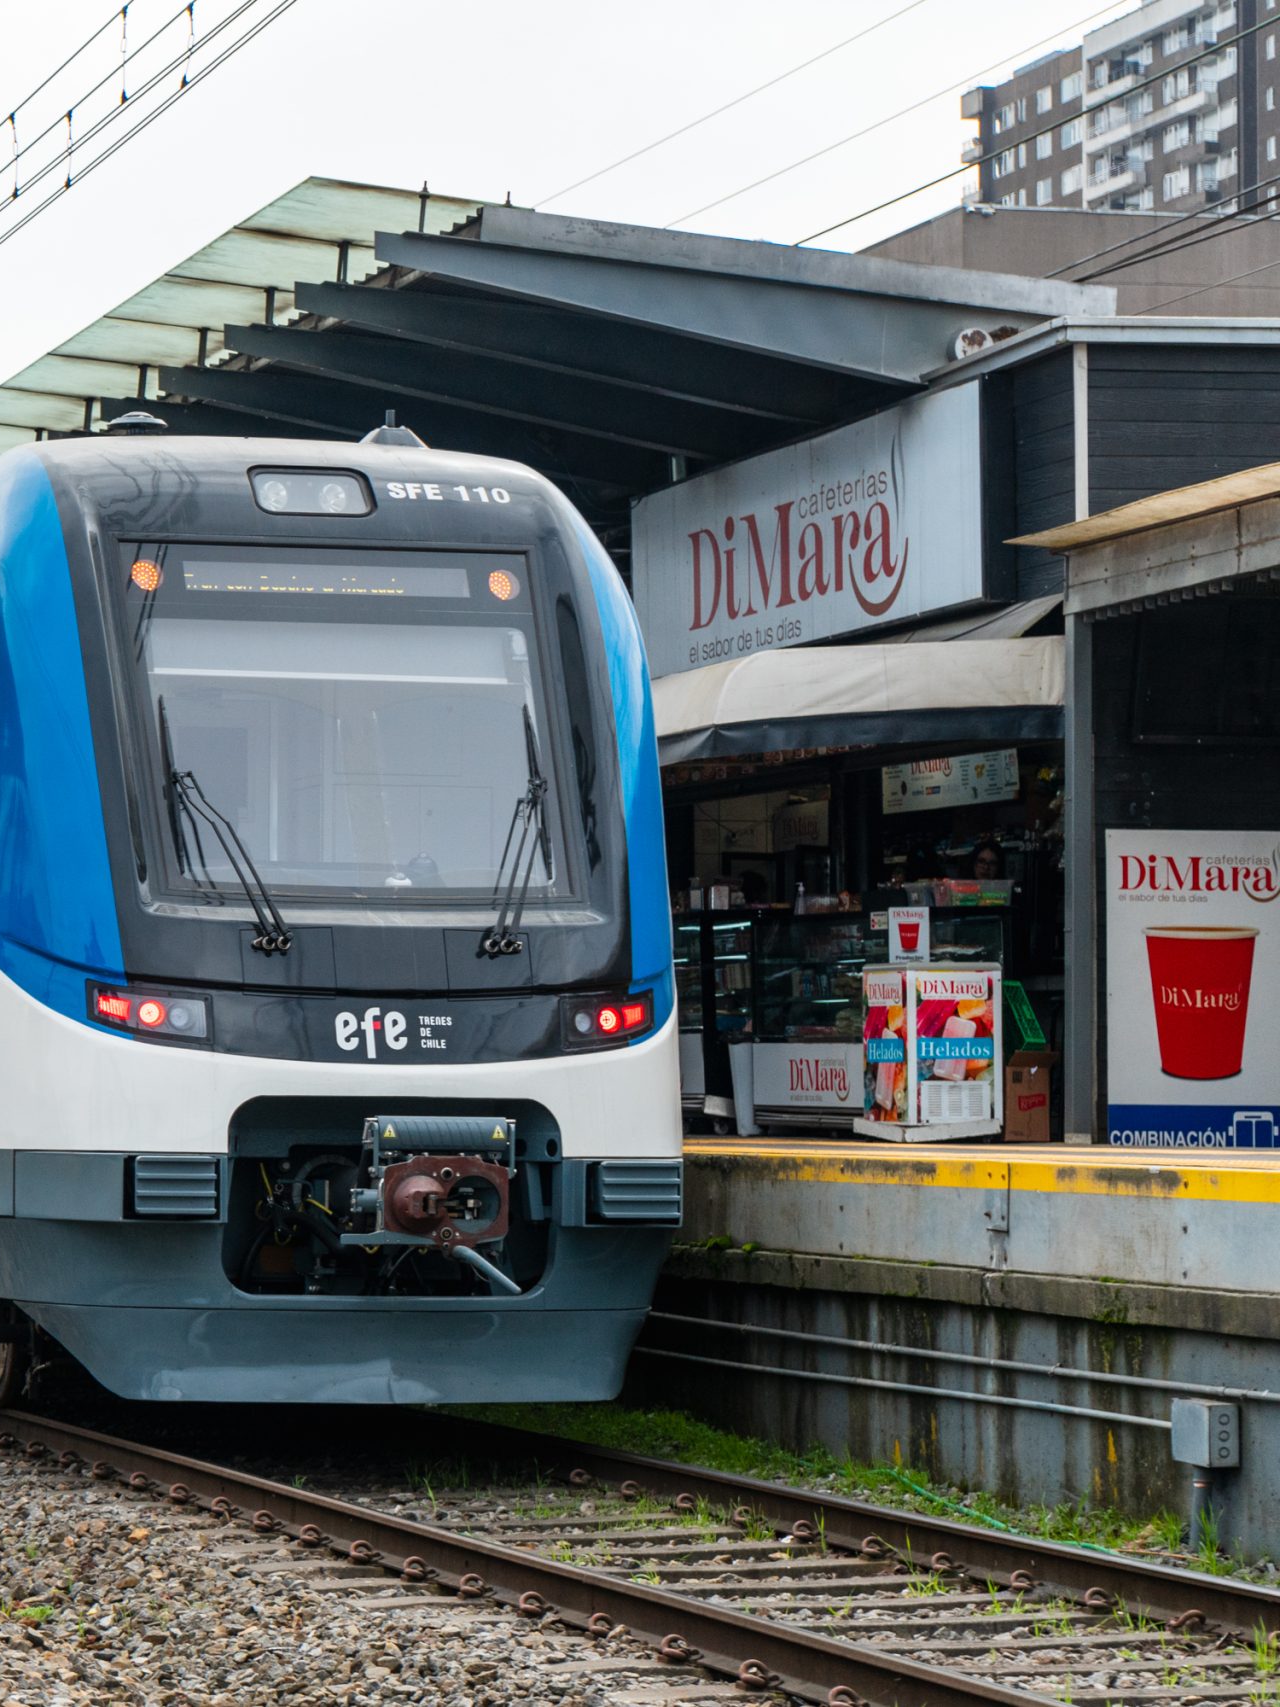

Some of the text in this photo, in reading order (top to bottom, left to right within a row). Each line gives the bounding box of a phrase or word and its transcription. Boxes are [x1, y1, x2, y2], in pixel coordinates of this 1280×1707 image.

[386, 482, 511, 504] SFE 110
[687, 500, 908, 632] DiMara
[689, 617, 802, 664] el sabor de tus días
[1118, 854, 1280, 900] DiMara
[1129, 893, 1155, 902] sabor
[1157, 893, 1170, 902] de
[922, 980, 986, 998] DiMara
[1161, 986, 1241, 1011] DiMara
[335, 1007, 408, 1059] efe
[420, 1027, 432, 1037] DE
[421, 1039, 447, 1049] CHILE
[868, 1042, 903, 1060] Helados
[920, 1041, 991, 1058] Helados
[789, 1058, 850, 1101] DiMara
[1110, 1127, 1227, 1148] COMBINACIÓN
